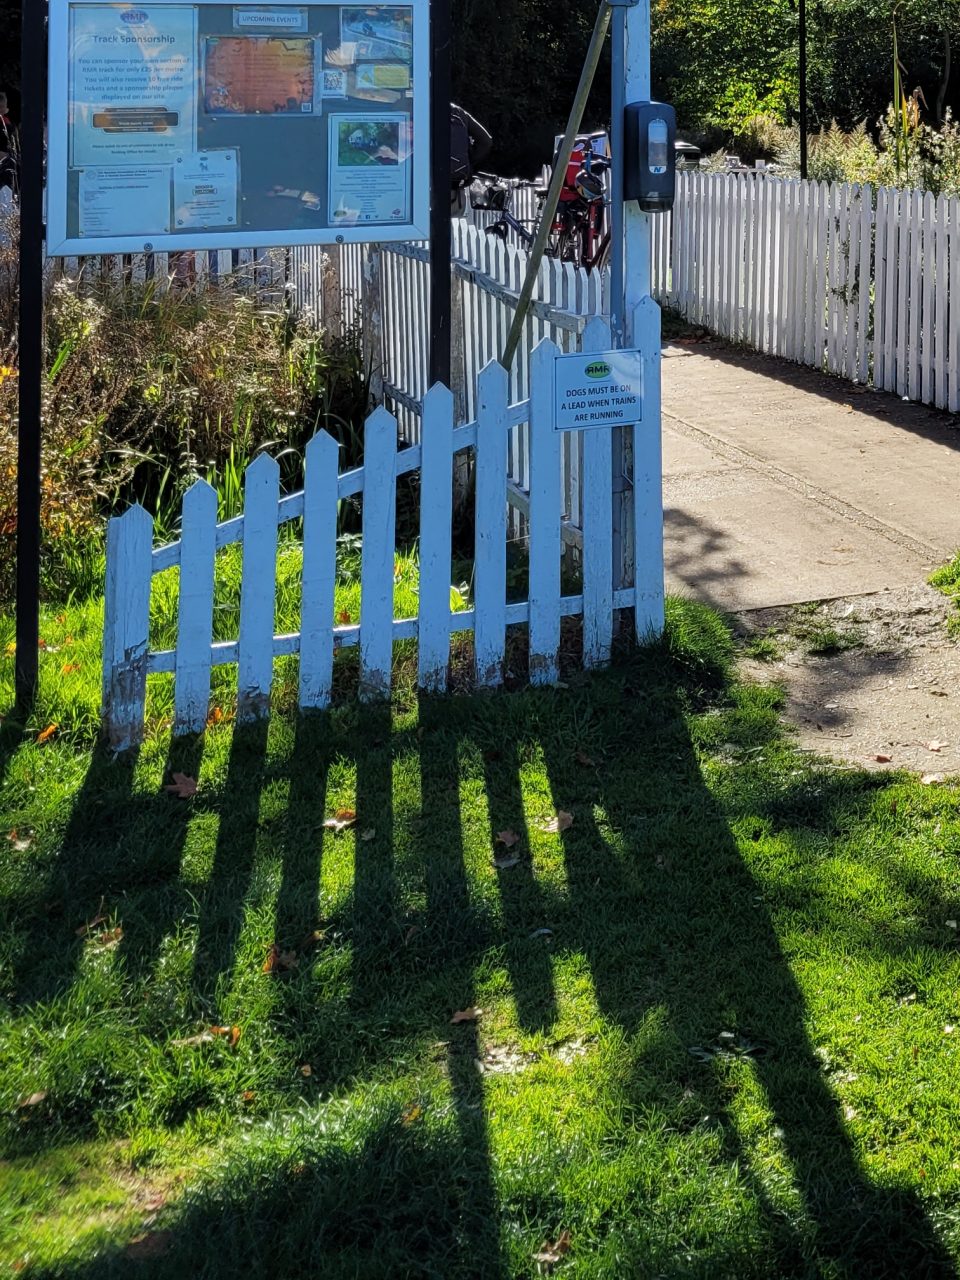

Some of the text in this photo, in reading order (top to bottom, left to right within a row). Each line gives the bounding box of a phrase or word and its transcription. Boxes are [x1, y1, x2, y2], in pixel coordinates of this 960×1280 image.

[93, 34, 175, 45] Track Sponsorship
[566, 384, 631, 397] DOGS MUST BE ON
[561, 396, 636, 410] A LEAD WHEN TRAINS
[574, 410, 623, 422] ARE RUNNING
